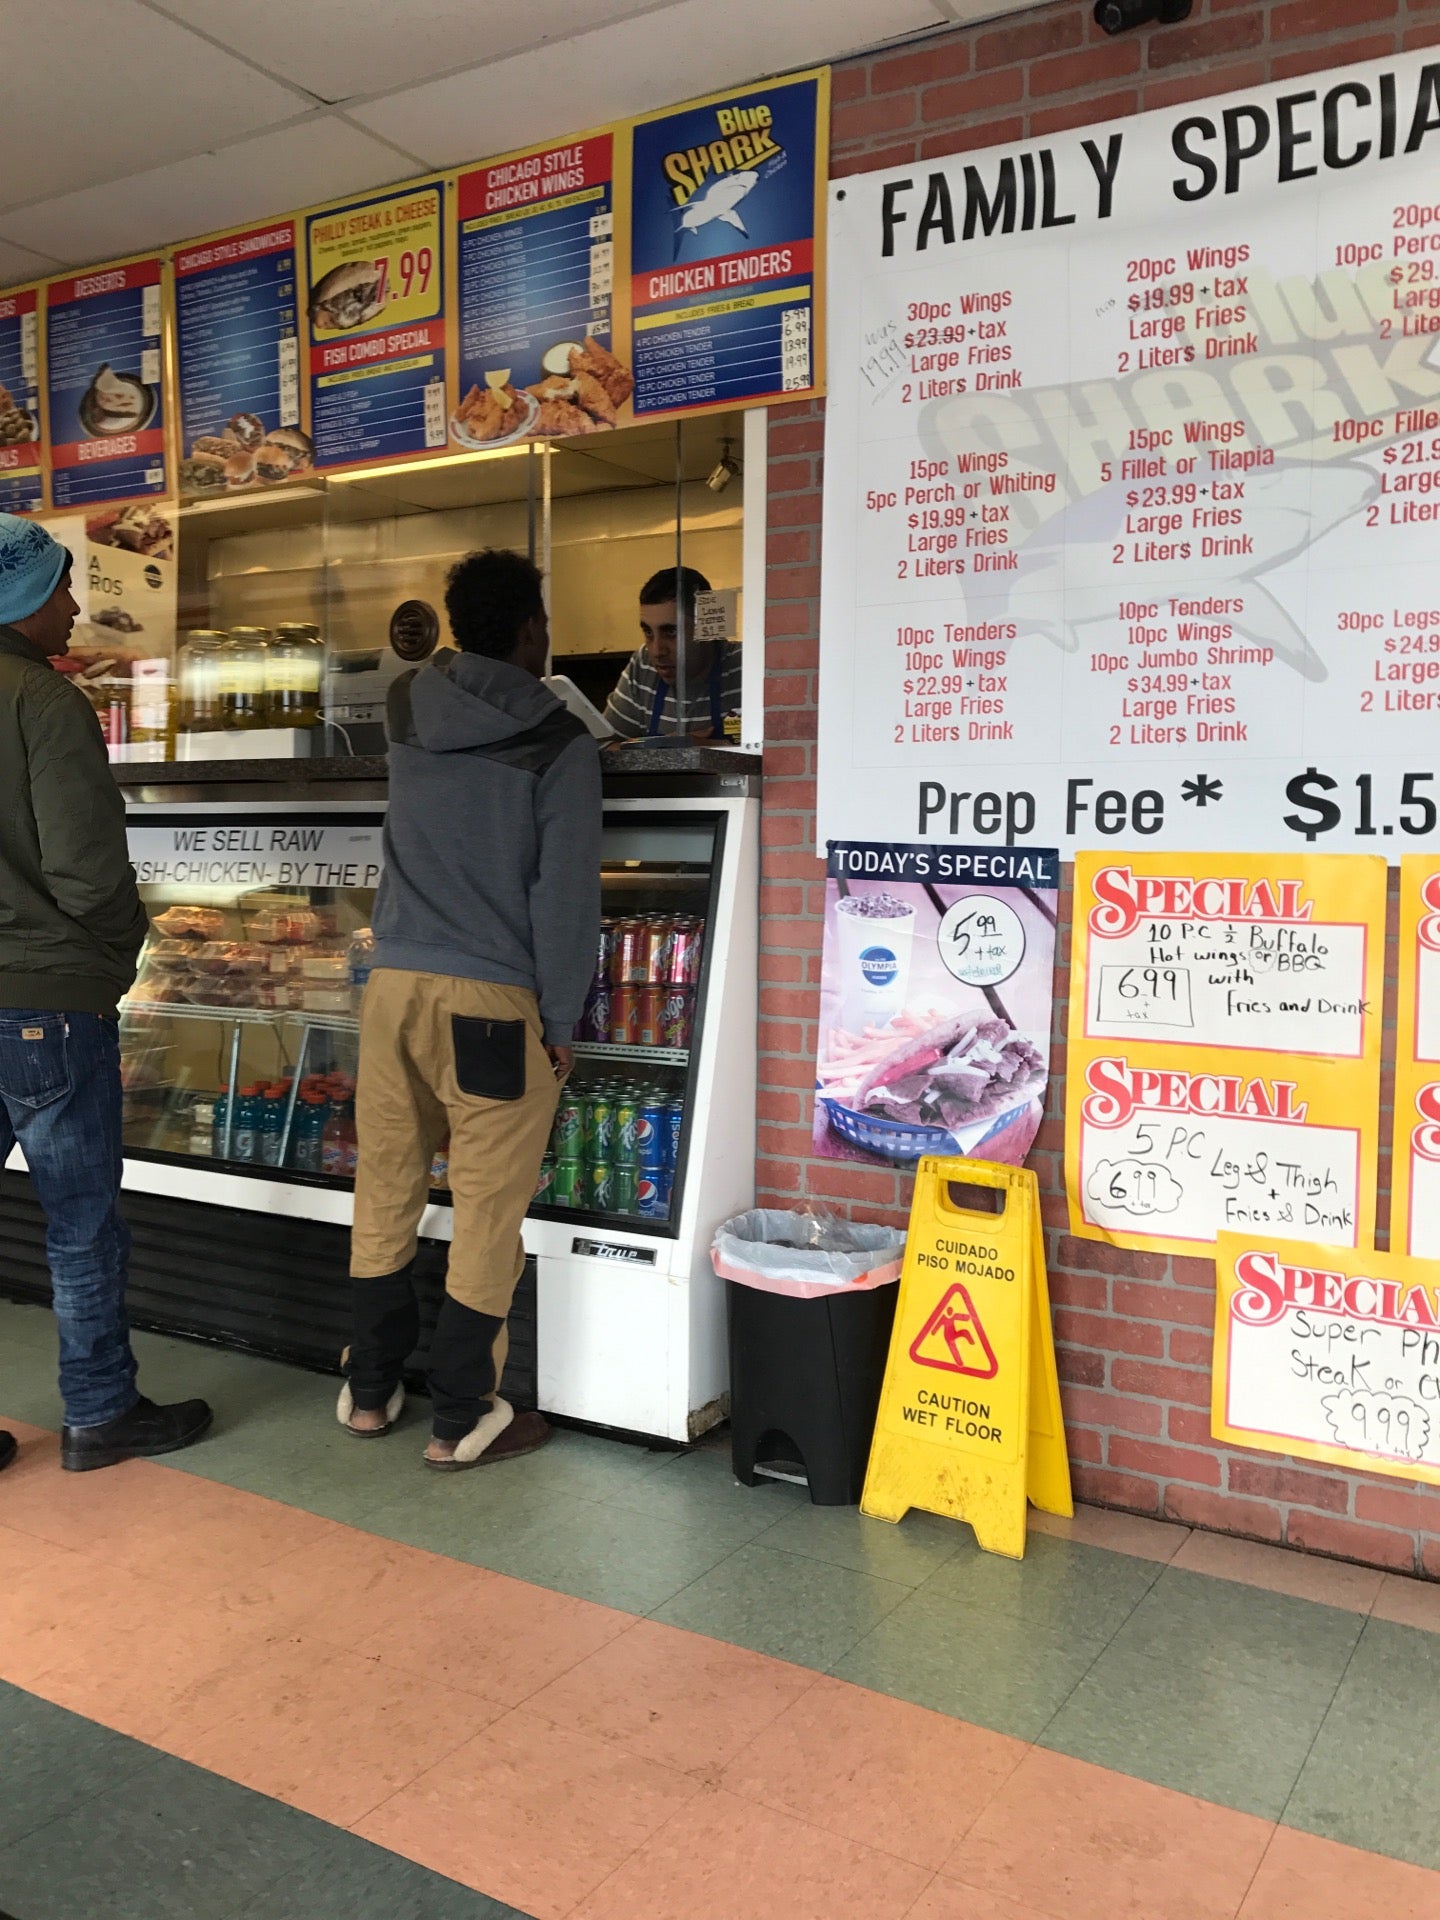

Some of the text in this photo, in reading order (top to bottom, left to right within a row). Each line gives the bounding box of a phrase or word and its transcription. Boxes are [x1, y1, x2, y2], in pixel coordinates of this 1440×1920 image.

[716, 104, 773, 136] Blue
[487, 146, 583, 188] CHICAGO STYLE
[663, 127, 782, 206] SHARK
[486, 181, 539, 210] CHICKEN
[542, 168, 584, 195] WINGS
[881, 133, 1123, 257] FAMILY
[396, 197, 437, 223] CHEESE
[1126, 244, 1250, 282] 20pc Wings
[1335, 243, 1383, 266] 10pc
[74, 270, 127, 298] DESSERTS
[374, 247, 432, 304] 7.99
[649, 264, 715, 299] CHICKEN
[719, 249, 792, 283] TENDERS
[907, 290, 1012, 322] 30pc Wings
[1128, 282, 1194, 312] $19.99
[1215, 276, 1248, 298] tax
[683, 326, 711, 338] TENDER
[904, 321, 1007, 349] $23.99 tax
[1130, 305, 1247, 340] Large Fries
[1380, 319, 1392, 340] 2
[348, 338, 386, 361] COMBO
[388, 329, 432, 353] SPECIAL
[685, 341, 713, 353] TENDER
[1118, 332, 1258, 373] 2 Liters Drink
[687, 356, 715, 368] TENDER
[911, 345, 1012, 374] Large Fries
[687, 372, 715, 384] TENDER
[902, 368, 1022, 403] 2 Liters Drink
[688, 388, 716, 400] TENDER
[1129, 420, 1245, 452] 15pc Wings
[1333, 418, 1384, 443] 10pc
[78, 435, 136, 461] BEVERAGES
[910, 452, 1008, 481] 15pc Wings
[1101, 445, 1275, 482] 5 Fillet or Tilapia
[867, 472, 1056, 512] 5pc Perch or Whiting
[1126, 481, 1245, 508] $23.99 tax
[908, 504, 1009, 530] $19.99 tax
[1126, 507, 1243, 535] Large Fries
[1366, 505, 1379, 527] 2
[909, 527, 1008, 553] Large Fries
[1113, 544, 1125, 564] 2
[1201, 534, 1254, 557] Drink
[898, 550, 1018, 579] 2 Liters Drink
[1119, 597, 1244, 622] 10pc Tenders
[1338, 611, 1384, 633] 30pc
[897, 622, 1017, 649] 10pc Tenders
[1128, 622, 1233, 647] 10pc Wings
[905, 649, 1006, 673] 10pc Wings
[1091, 645, 1274, 674] 10pc Jumbo Shrimp
[1375, 660, 1440, 684] Large
[903, 674, 1007, 696] $22.99 tax
[1127, 672, 1231, 694] $34.99 tax
[905, 696, 1004, 720] Large Fries
[1122, 694, 1236, 720] Large Fries
[1360, 690, 1373, 712] 2
[894, 721, 1014, 743] 2 Liters Drink
[1109, 721, 1248, 745] 2 Liters Drink
[918, 778, 1164, 846] Prep Fee
[173, 830, 324, 852] WE SELL RAW
[278, 863, 309, 884] BY
[314, 864, 358, 886] THE
[834, 850, 1052, 880] TODAY'S SPECIAL
[1091, 867, 1312, 937] SPECIAL
[986, 944, 1007, 961] tax
[1147, 923, 1328, 955] 10 Buffalo
[861, 961, 897, 971] OLYMPIA
[1150, 946, 1325, 972] Hot wings BBQ
[1208, 968, 1254, 986] with
[1279, 998, 1373, 1015] and Drink
[1083, 1058, 1307, 1127] SPECIAL
[1128, 1124, 1161, 1155] 5
[1211, 1148, 1338, 1197] Leg Thigh
[1226, 1197, 1353, 1230] Fries Drink
[936, 1239, 998, 1261] CUIDADO
[917, 1253, 1015, 1282] PISO MOJADO
[1291, 1310, 1381, 1353] Super
[1385, 1377, 1403, 1390] or
[917, 1390, 990, 1420] CAUTION
[902, 1406, 1002, 1443] WET FLOOR
